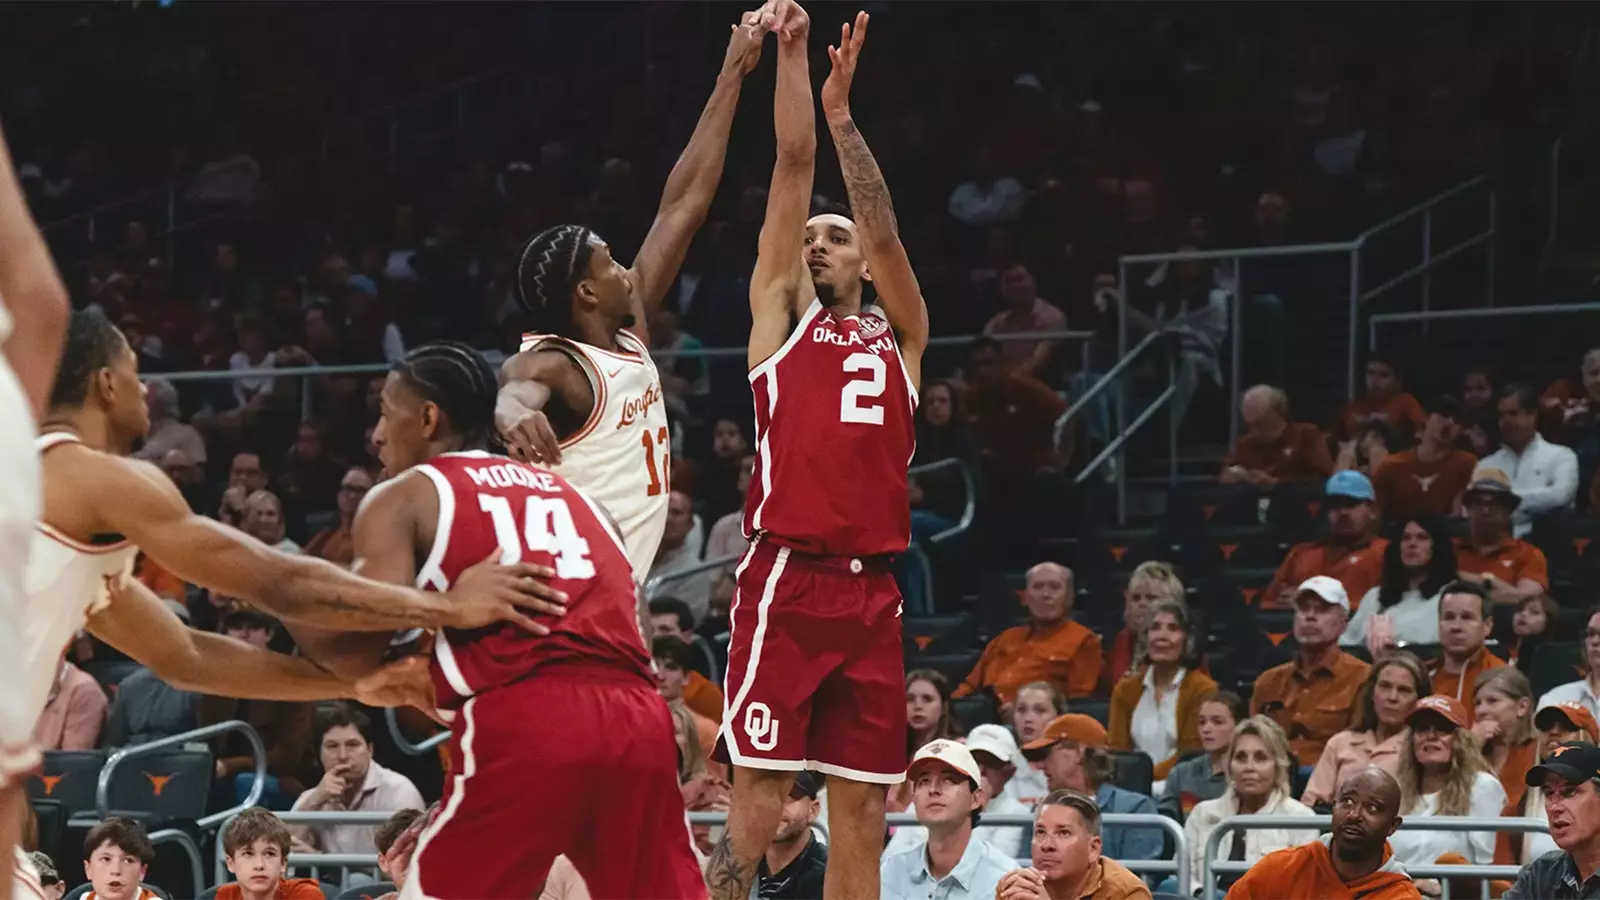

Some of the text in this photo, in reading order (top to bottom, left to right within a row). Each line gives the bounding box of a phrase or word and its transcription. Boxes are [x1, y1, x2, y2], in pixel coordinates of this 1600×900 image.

[813, 327, 895, 355] OKLAMA
[840, 352, 887, 425] 2
[464, 463, 562, 492] MOORE
[477, 493, 596, 579] 14
[744, 701, 779, 751] OU
